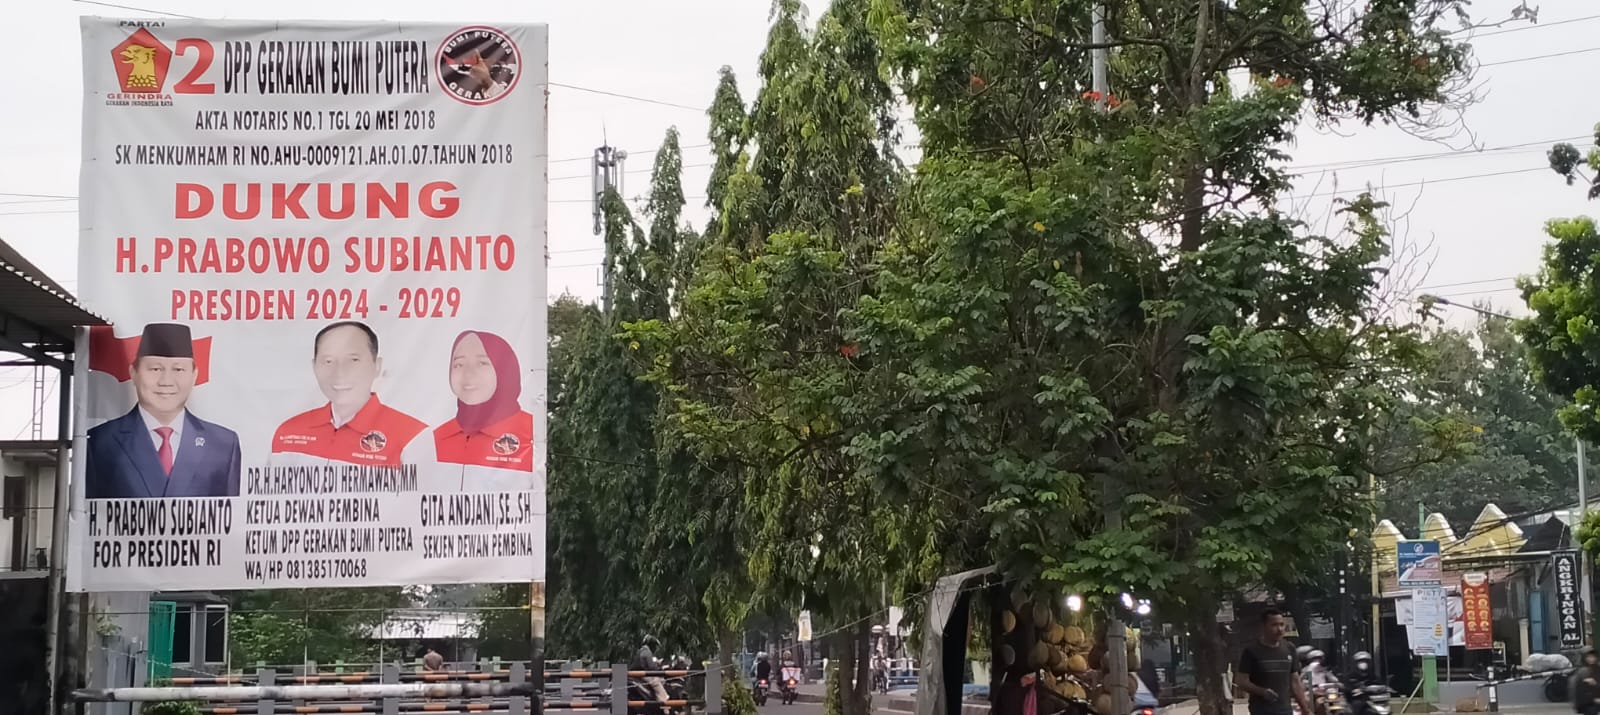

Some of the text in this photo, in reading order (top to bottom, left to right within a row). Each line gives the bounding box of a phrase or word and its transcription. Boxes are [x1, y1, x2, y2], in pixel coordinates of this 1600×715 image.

[120, 20, 165, 28] PARTAI
[445, 31, 512, 55] BUMI PUTERA
[173, 37, 215, 94] 2
[224, 40, 430, 94] DPP GERAKAN BUMI PUTERA
[195, 110, 435, 131] AKTA NOTARIS NO.1 TGL 20 MEI 2018
[115, 144, 132, 165] SK
[136, 145, 228, 165] MENKUMHAM
[233, 145, 245, 165] RI
[482, 144, 513, 164] 2018
[175, 181, 460, 220] DUKUNG
[116, 234, 516, 274] H.PRABOWO SUBIANTO
[171, 288, 295, 321] PRESIDEN
[306, 288, 369, 320] 2024
[399, 287, 461, 318] 2029
[89, 499, 232, 537] H. PRABOWO SUBIANTO
[246, 498, 380, 524] KETUA DEWAN PEMBINA
[420, 494, 445, 527] GITA
[93, 539, 221, 568] FOR PRESIDEN RI
[245, 527, 413, 554] KETUM DPP GERAKAN BUMI PUTERA
[423, 532, 533, 559] SEKJEN DEWAN PEMBINA
[245, 558, 367, 585] WA/HP 081385170068
[1558, 557, 1577, 629] ANGKRINGAN
